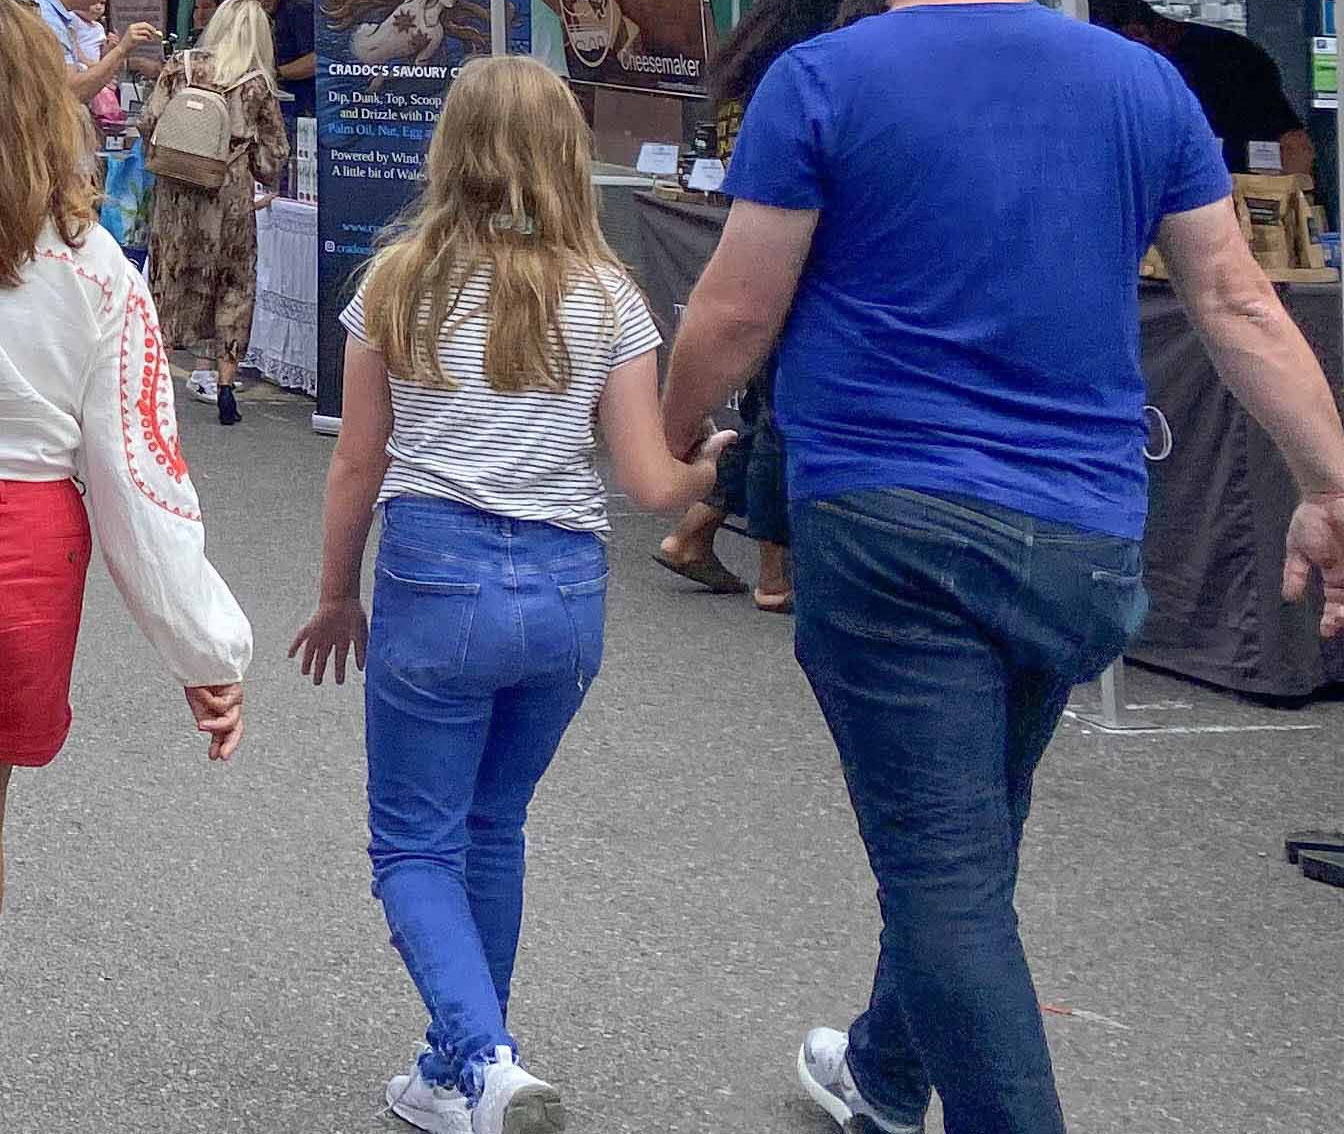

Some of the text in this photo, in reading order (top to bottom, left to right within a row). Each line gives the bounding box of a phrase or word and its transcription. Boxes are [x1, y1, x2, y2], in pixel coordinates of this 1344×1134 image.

[328, 64, 389, 76] CRADOC'S
[393, 66, 447, 78] SAVOURY
[620, 53, 700, 77] Cheesemaker
[328, 91, 350, 104] Dip,
[352, 92, 383, 104] Dunk,
[386, 93, 407, 106] Top,
[340, 108, 358, 118] and
[362, 108, 398, 120] Drizzle
[400, 110, 422, 121] with
[328, 123, 354, 134] Palm
[331, 150, 374, 161] Powered
[376, 151, 389, 165] by
[392, 152, 422, 165] Wind,
[332, 166, 341, 176] A
[342, 166, 366, 177] little
[368, 167, 382, 178] bit
[384, 168, 395, 178] of
